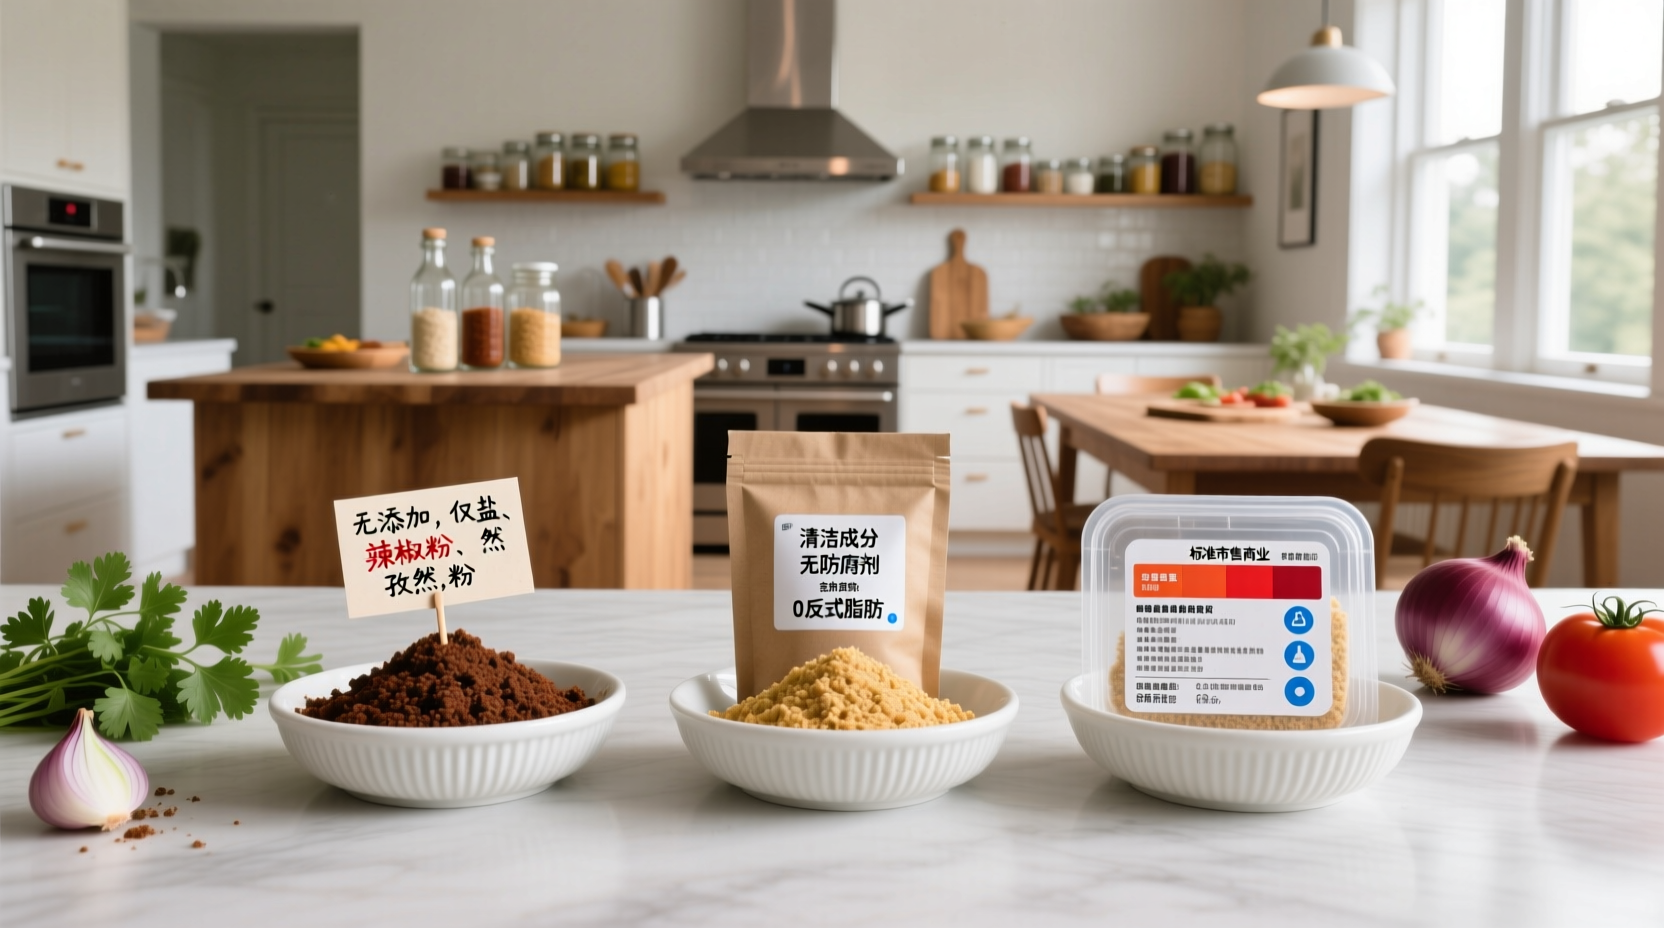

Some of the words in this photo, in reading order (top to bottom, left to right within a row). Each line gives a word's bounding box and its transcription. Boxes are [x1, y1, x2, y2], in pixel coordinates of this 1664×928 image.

[800, 527, 879, 549] 清洁成分
[792, 597, 885, 620] 0反式脂肪
